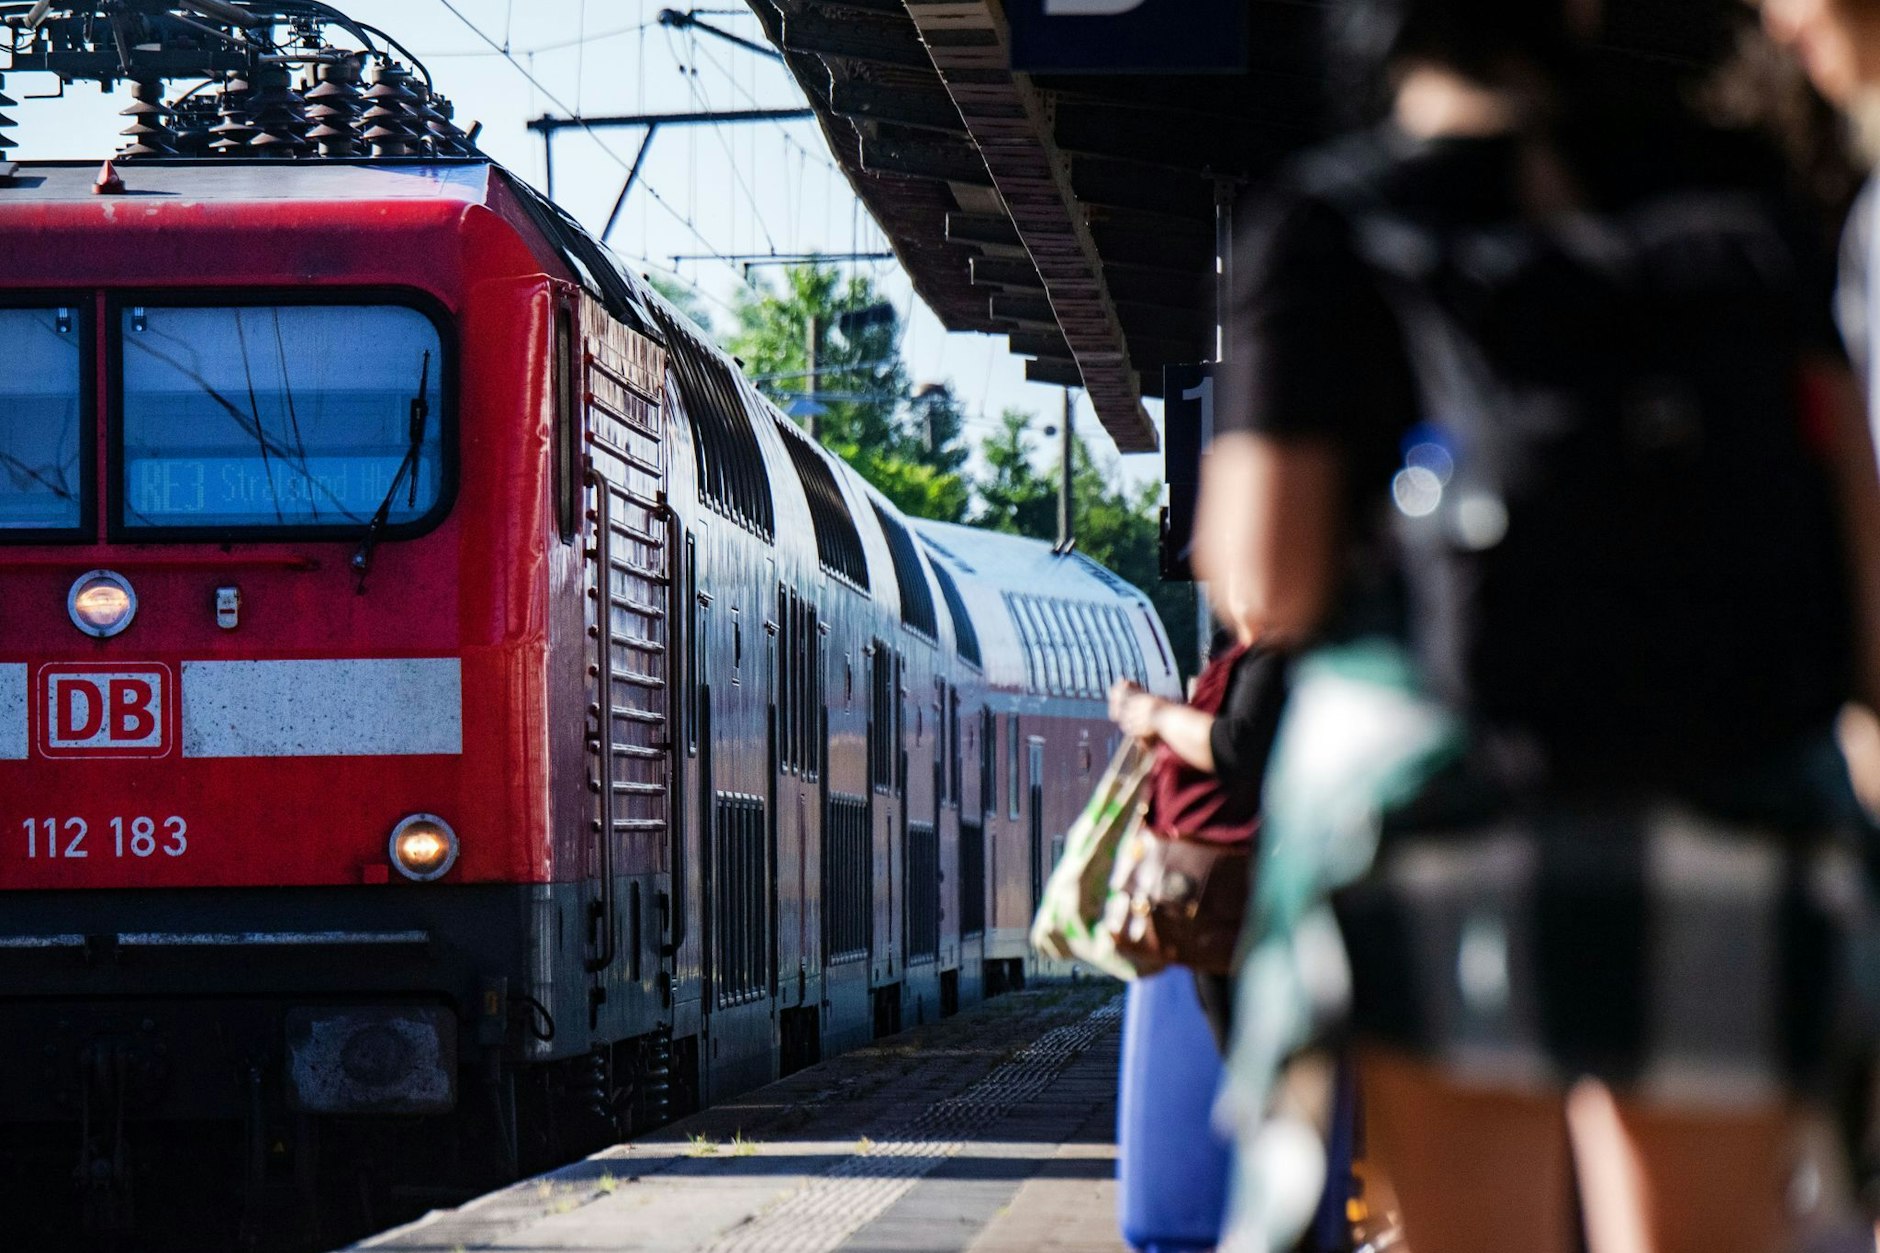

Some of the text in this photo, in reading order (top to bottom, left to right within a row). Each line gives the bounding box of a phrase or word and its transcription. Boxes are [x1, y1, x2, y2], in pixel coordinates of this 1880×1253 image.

[141, 461, 400, 512] RE3 Stralsund Hb
[56, 679, 155, 741] DB
[23, 816, 187, 858] 112 183
